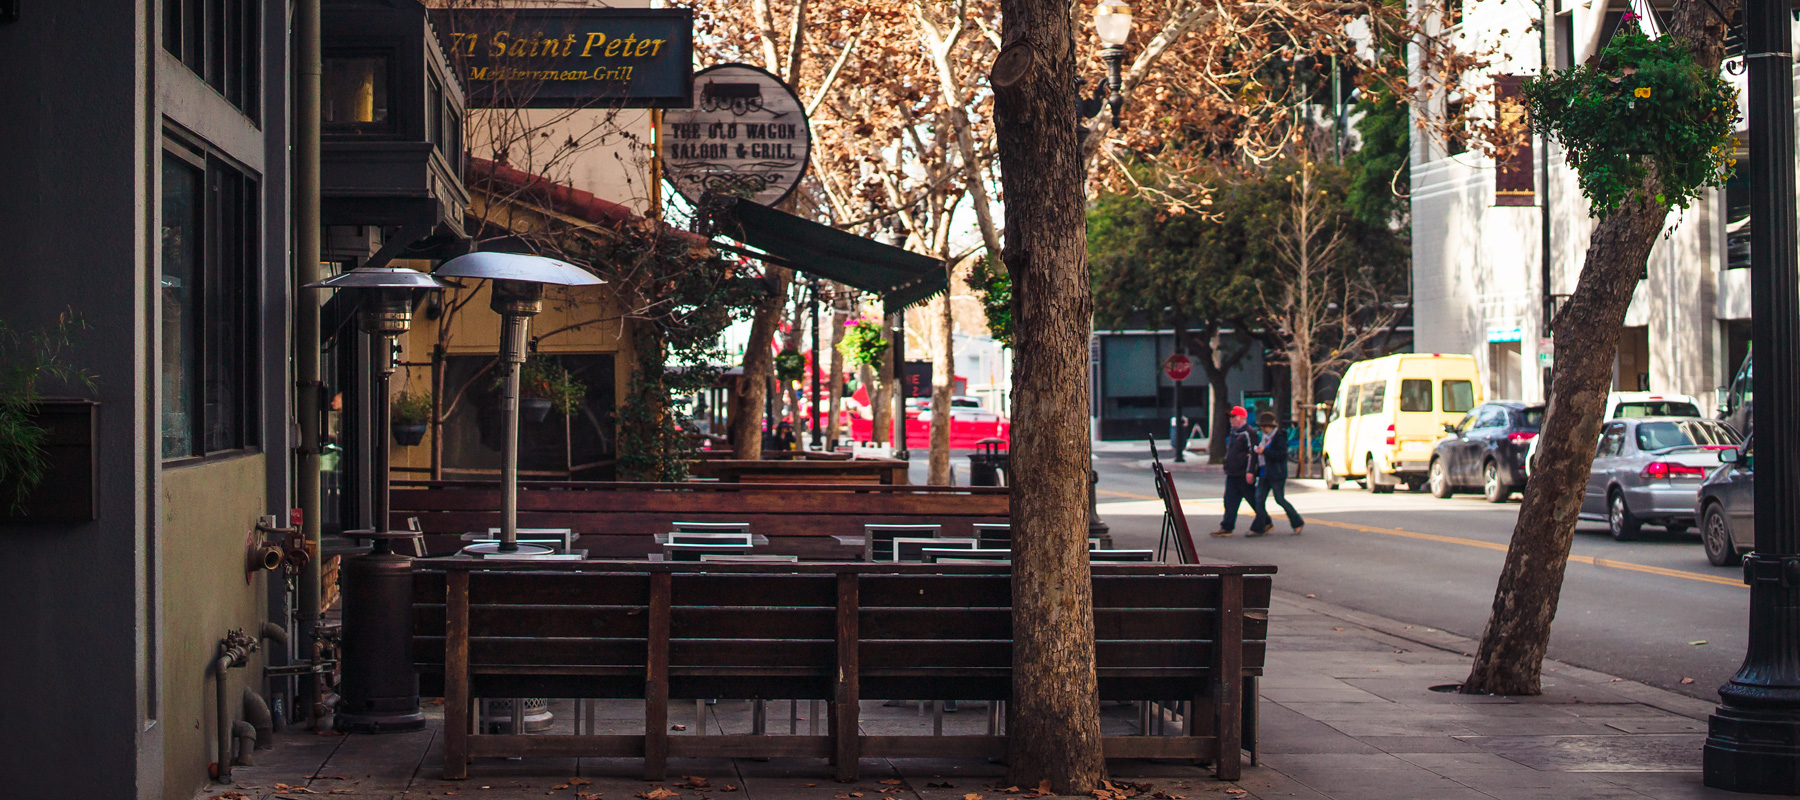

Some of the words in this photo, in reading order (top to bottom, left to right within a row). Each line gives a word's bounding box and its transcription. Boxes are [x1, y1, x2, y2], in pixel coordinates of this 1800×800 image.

[449, 32, 478, 57] 71
[488, 30, 577, 57] Saint
[579, 32, 667, 57] Peter
[468, 66, 587, 81] Mediterranean
[592, 65, 634, 81] Grill
[671, 123, 700, 139] THE
[708, 123, 737, 139] OLD
[746, 123, 796, 139] WAGON
[671, 143, 728, 159] SALOON
[736, 143, 749, 159] &
[752, 143, 796, 159] GRILL
